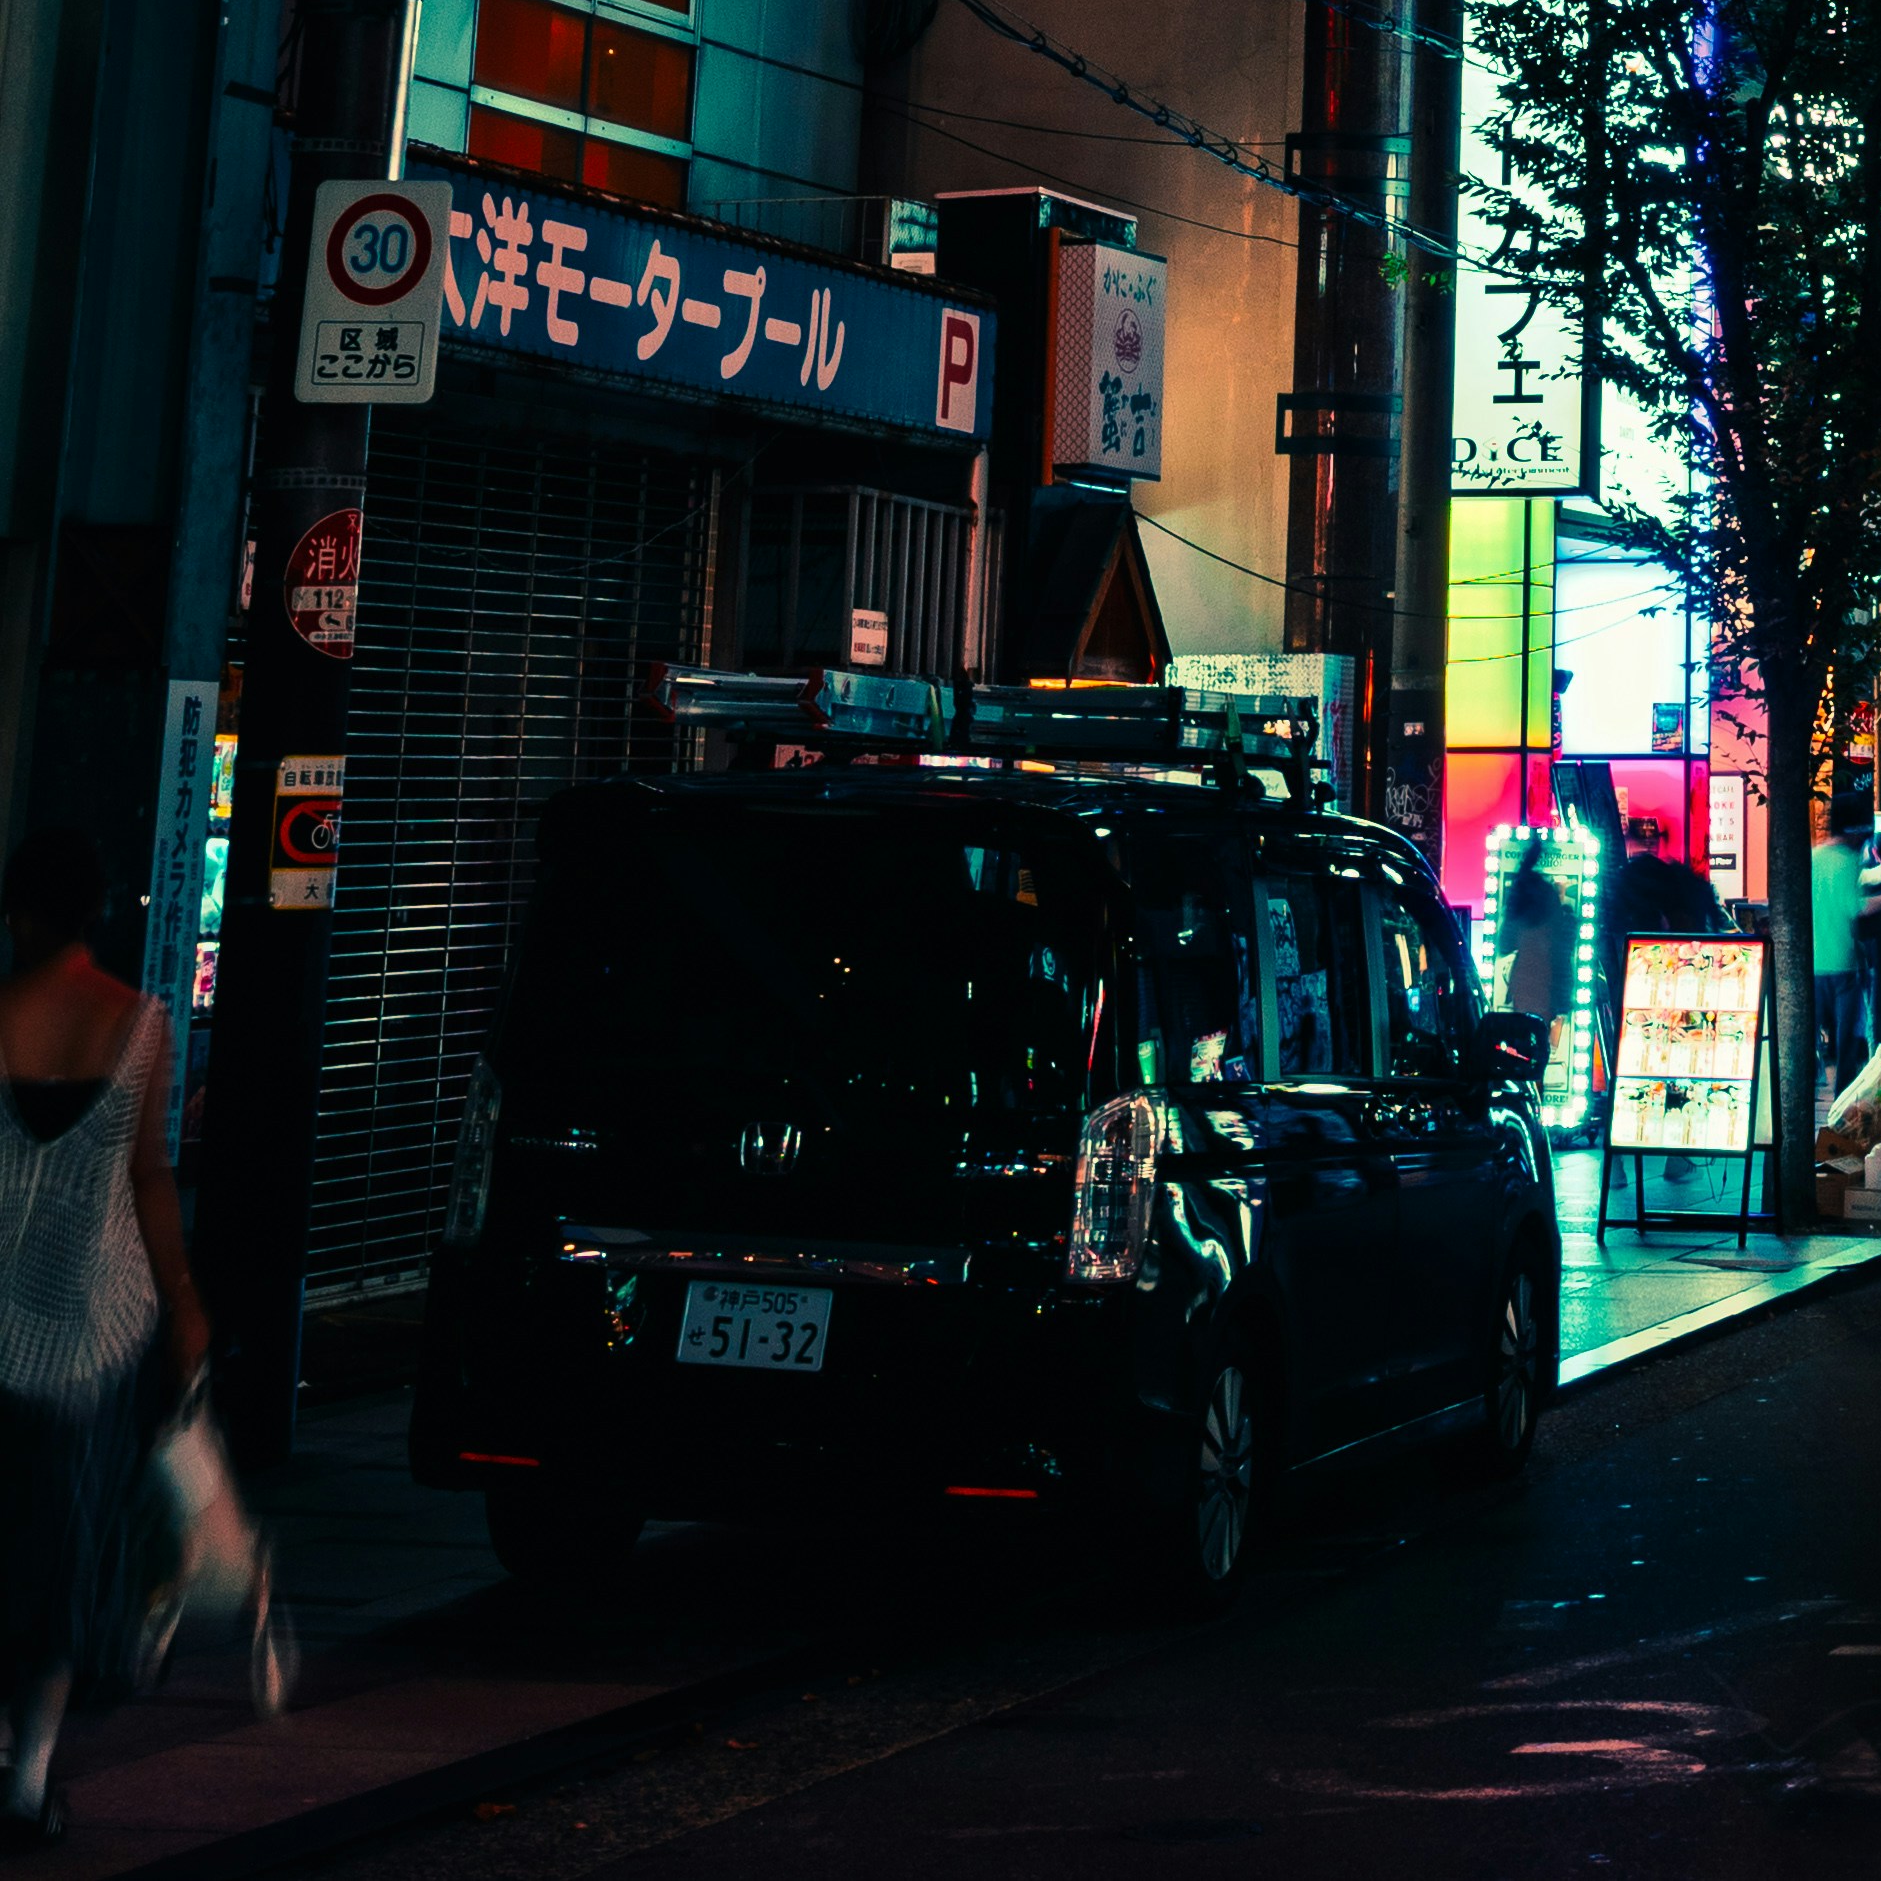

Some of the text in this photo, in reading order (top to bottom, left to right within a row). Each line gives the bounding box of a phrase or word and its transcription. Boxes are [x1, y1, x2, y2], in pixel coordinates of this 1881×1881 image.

[350, 223, 409, 274] 30
[339, 327, 399, 352] 区域
[316, 353, 416, 379] ここから
[940, 315, 976, 420] P
[708, 1315, 819, 1365] 51-32
